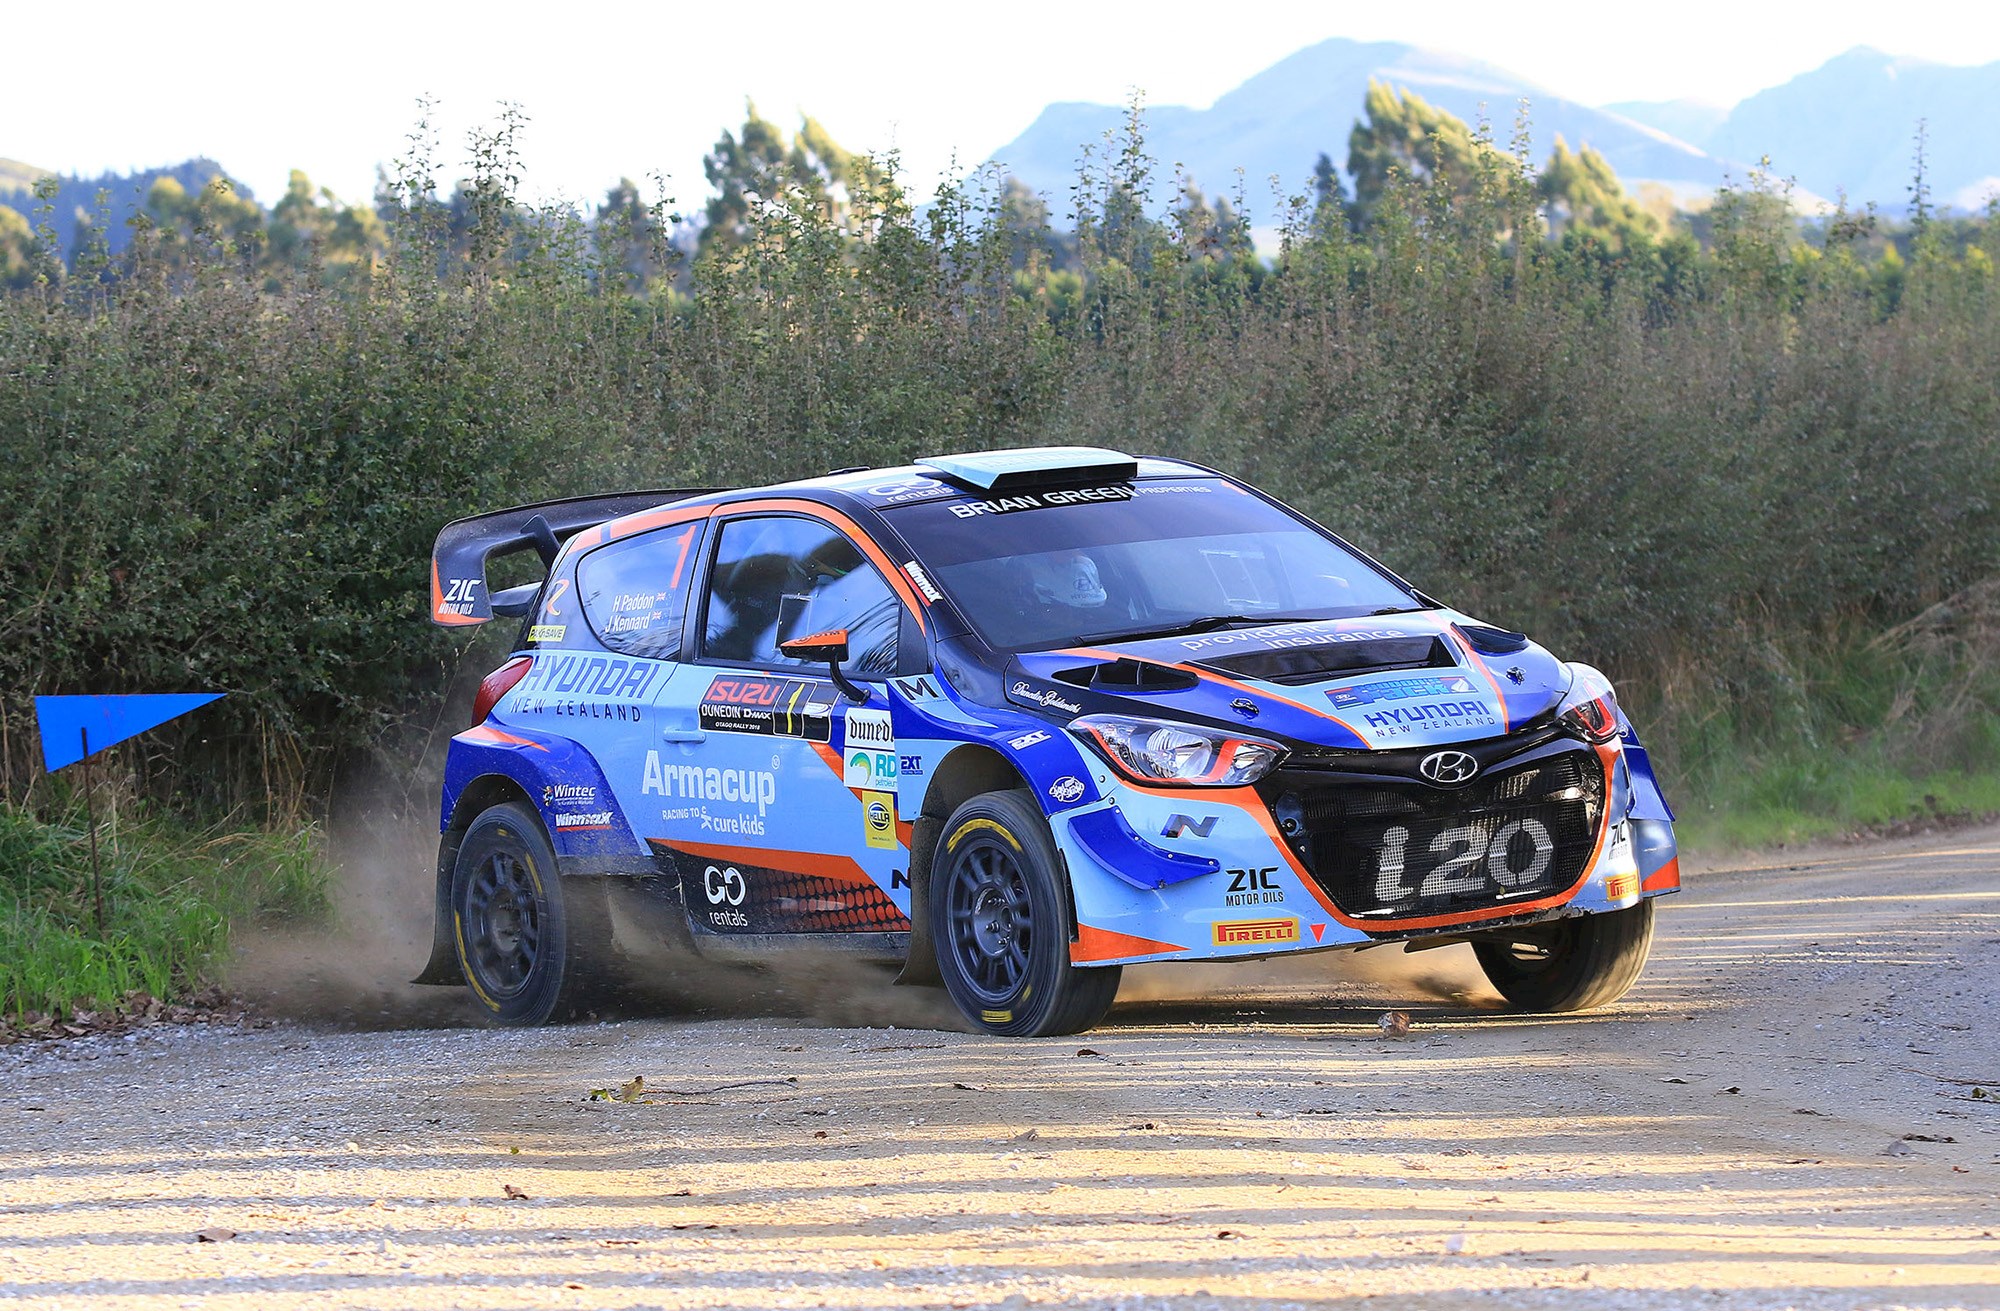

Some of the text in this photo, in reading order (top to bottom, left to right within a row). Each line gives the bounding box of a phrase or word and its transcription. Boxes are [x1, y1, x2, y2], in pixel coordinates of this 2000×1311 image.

[886, 486, 955, 503] rentals
[948, 485, 1212, 519] BRIAN GREEN PROPERTIES
[669, 525, 697, 589] 1
[443, 579, 482, 601] ZIC
[438, 602, 474, 615] MOTOR OILS
[612, 593, 655, 612] H Paddon
[605, 612, 651, 633] J Kennard
[1181, 622, 1330, 651] provident
[1264, 628, 1408, 650] insurance
[520, 655, 660, 699] HYUNDAI
[705, 681, 781, 706] ISUZU
[511, 698, 641, 722] NEW ZEALAND
[701, 703, 741, 718] DUNEDIN
[787, 682, 805, 734] 1
[1364, 700, 1490, 728] HYUNDAI
[1376, 717, 1496, 738] NEW ZEALAND
[900, 755, 922, 770] EXT
[554, 784, 596, 798] Wintec
[642, 750, 776, 817] Armacup
[662, 806, 700, 820] RACING TO
[870, 811, 890, 823] HELLA
[714, 813, 765, 836] cure kids
[704, 865, 746, 906] GO
[1225, 866, 1281, 892] ZIC
[1225, 891, 1284, 907] MOTOR OILS
[709, 908, 748, 927] rentals
[1217, 920, 1293, 942] PIRELLI
